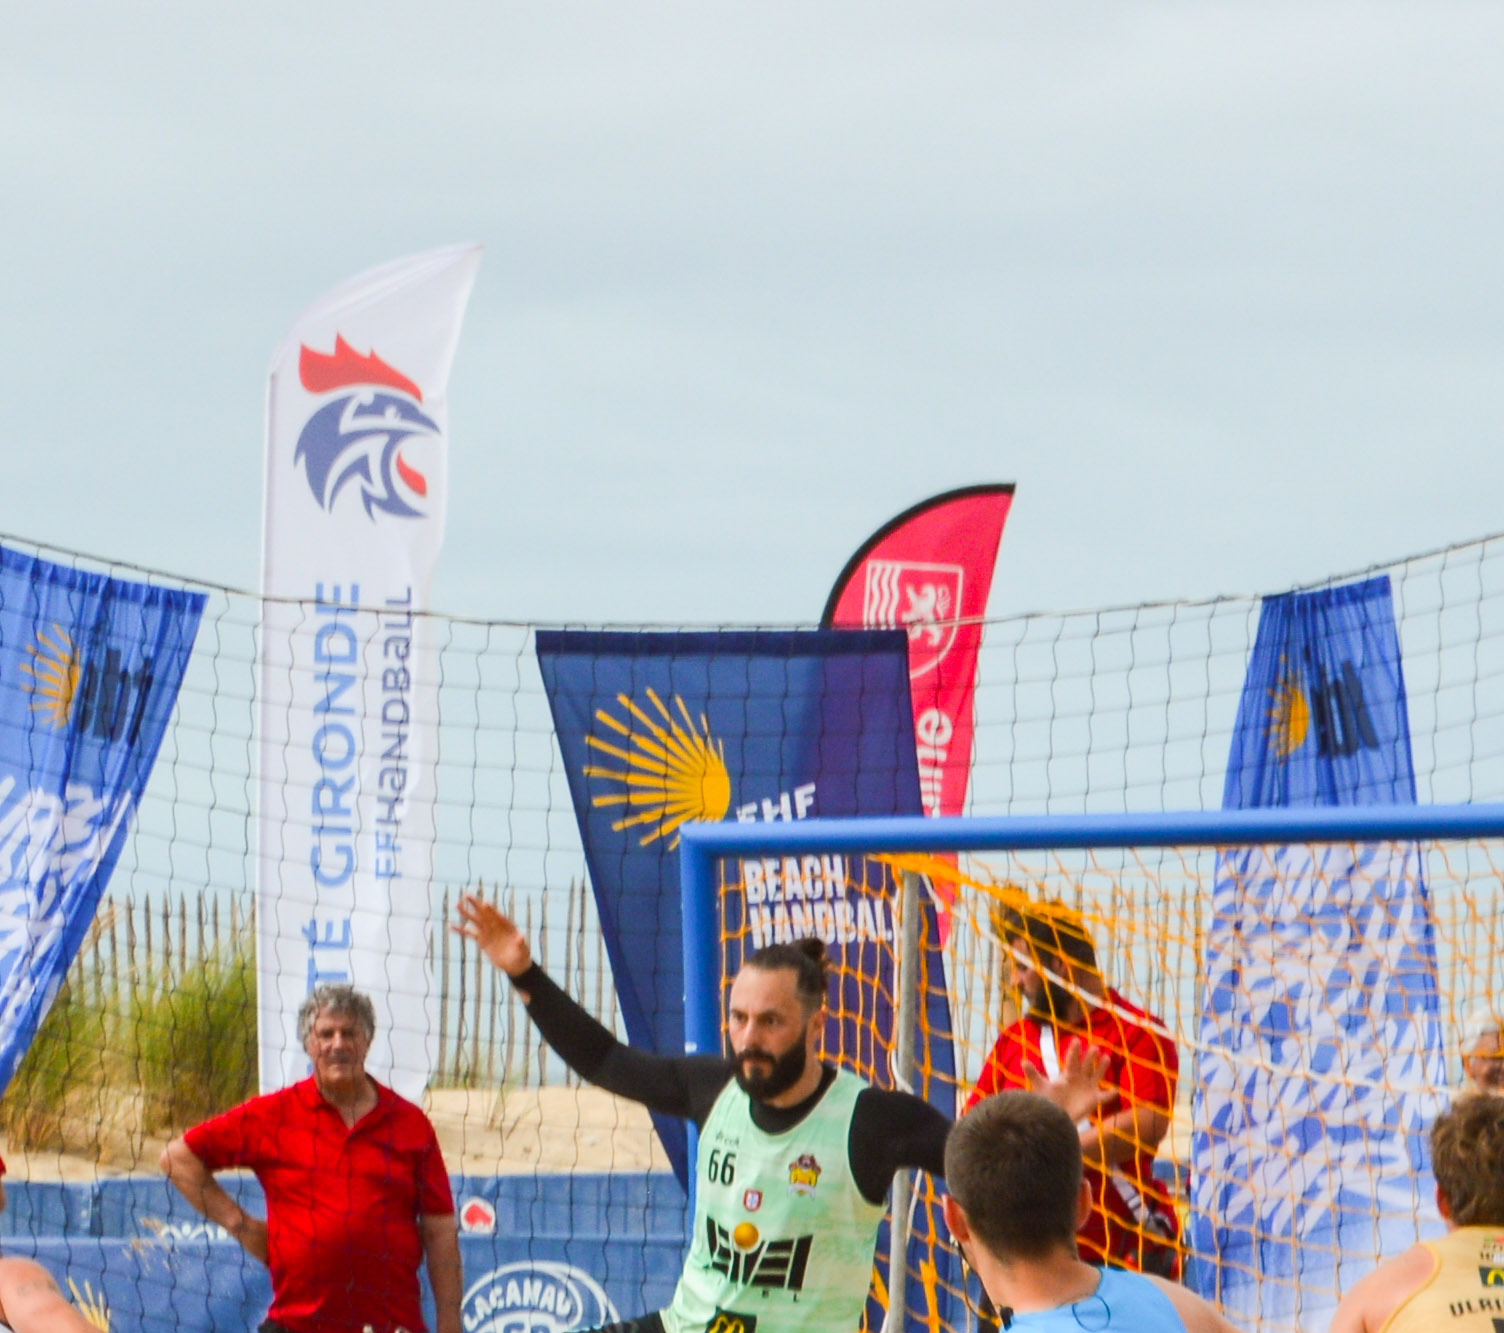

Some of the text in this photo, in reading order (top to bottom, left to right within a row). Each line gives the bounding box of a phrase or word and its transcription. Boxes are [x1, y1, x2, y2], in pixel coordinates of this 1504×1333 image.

[310, 583, 359, 887] GIRONDE
[744, 853, 844, 904] BEACH
[749, 898, 894, 950] HANDBAL
[708, 1148, 737, 1186] 66
[463, 1277, 573, 1333] LACANAU
